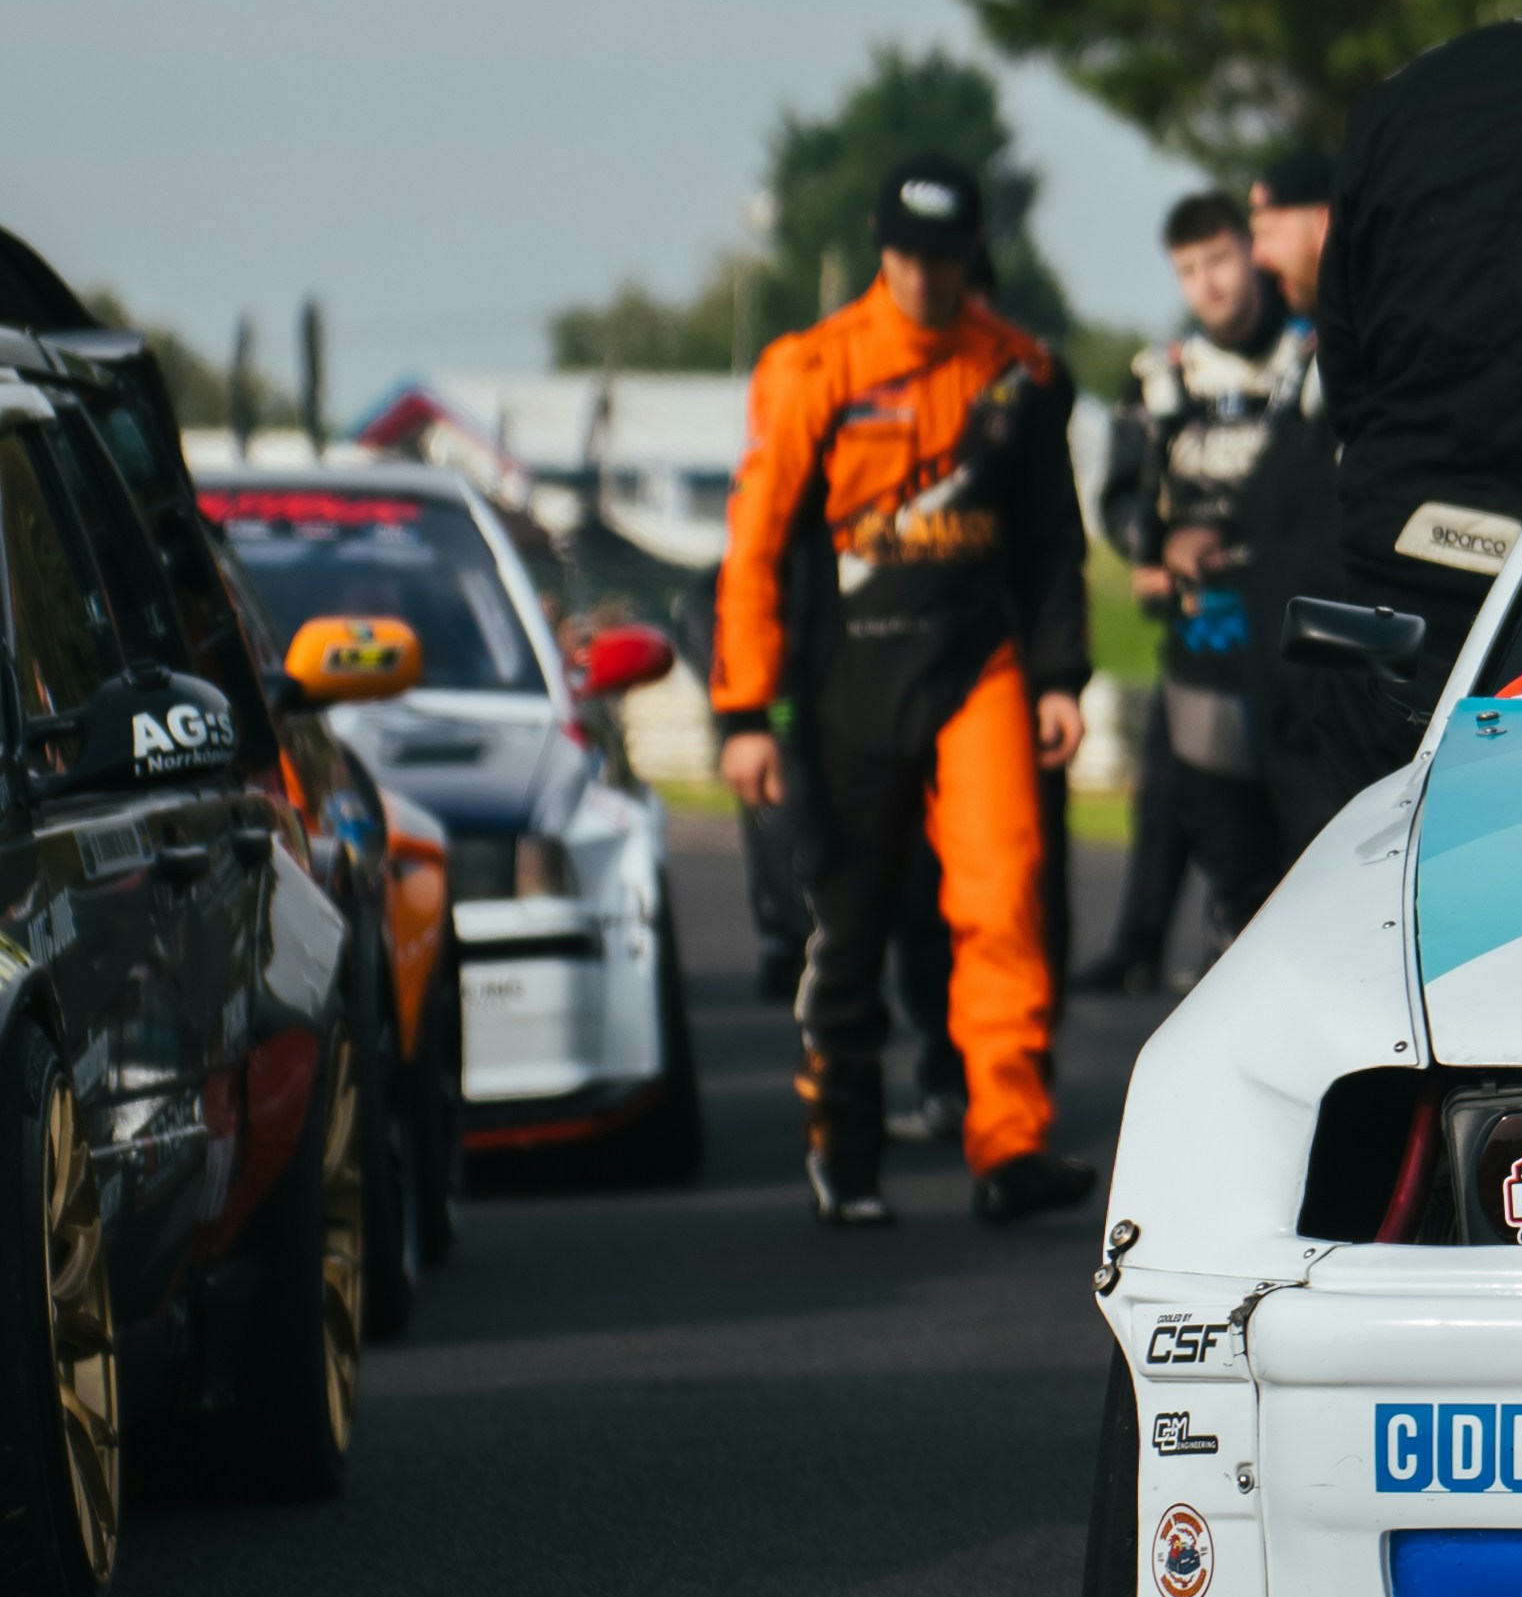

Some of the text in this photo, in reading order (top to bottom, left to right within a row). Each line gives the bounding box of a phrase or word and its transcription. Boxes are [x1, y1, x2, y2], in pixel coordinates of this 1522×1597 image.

[1157, 1313, 1192, 1324] COOLED BY
[1146, 1324, 1229, 1364] CSF
